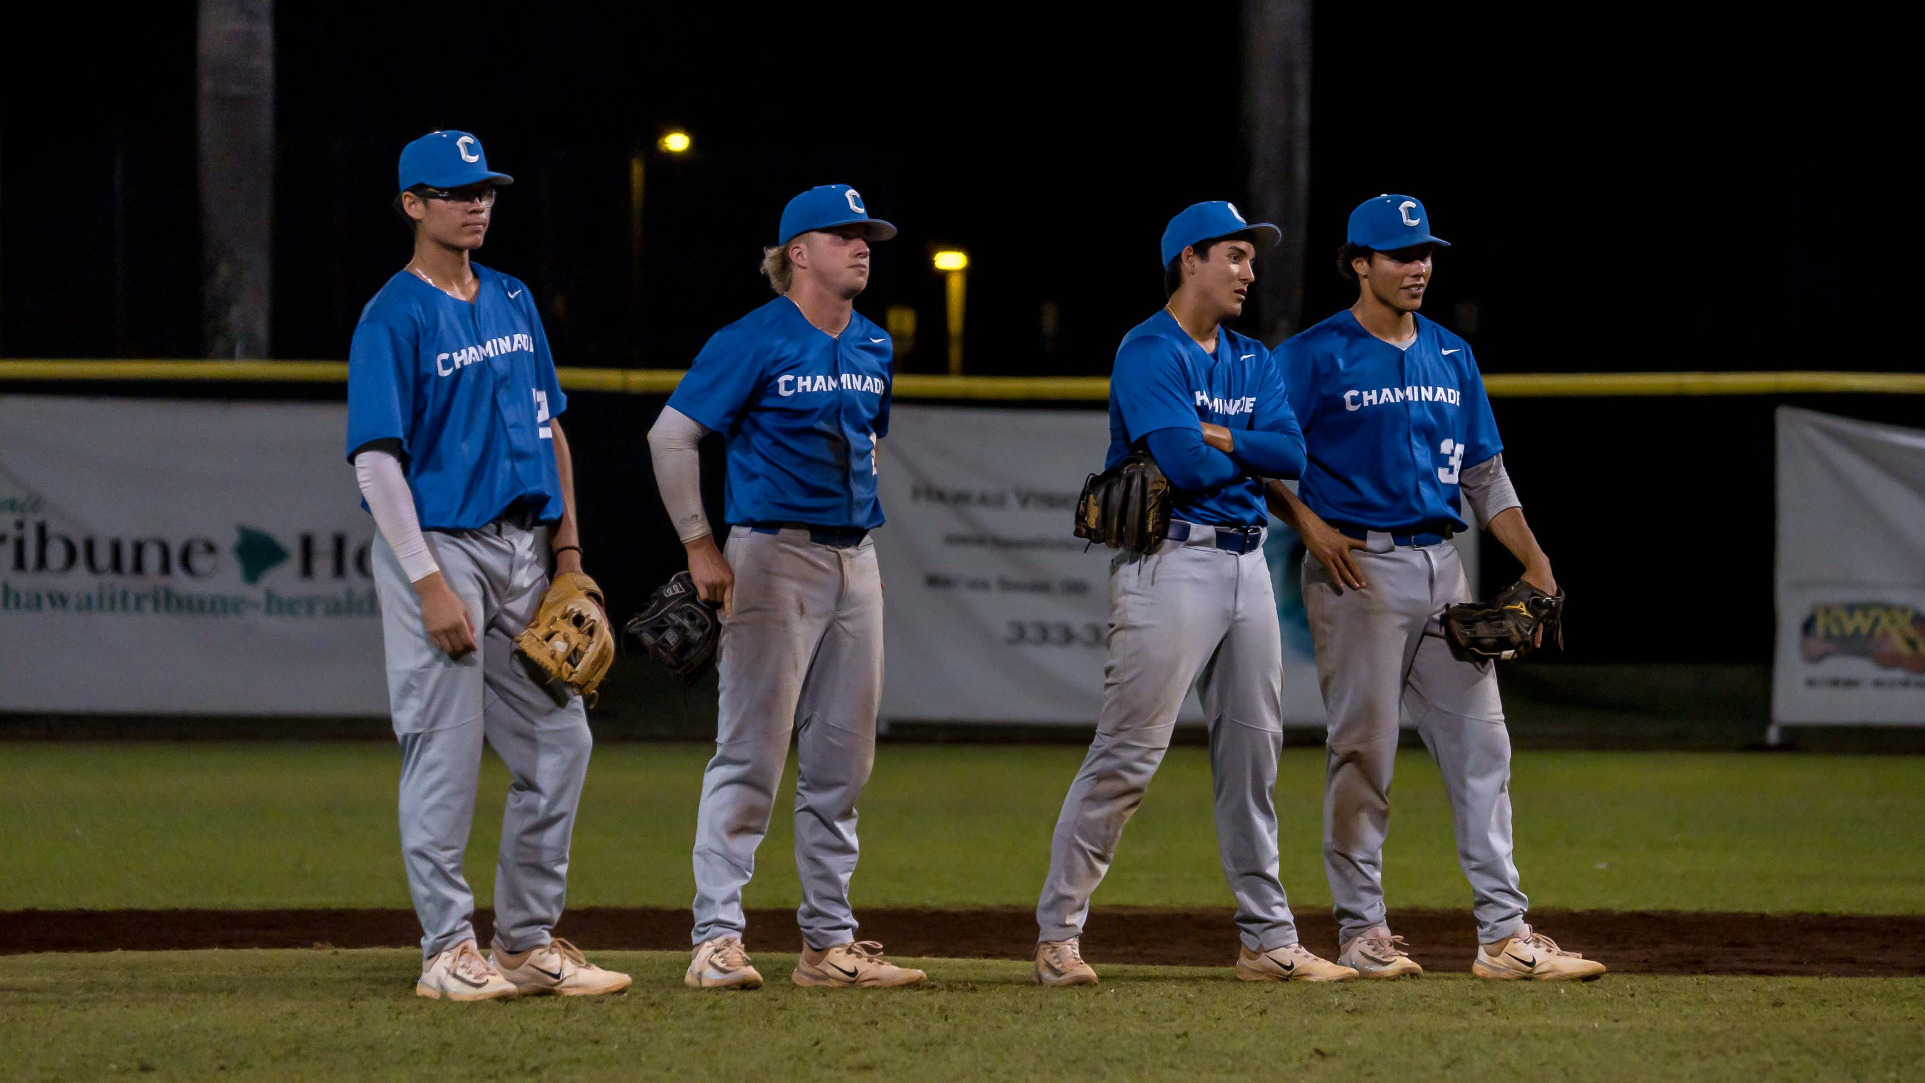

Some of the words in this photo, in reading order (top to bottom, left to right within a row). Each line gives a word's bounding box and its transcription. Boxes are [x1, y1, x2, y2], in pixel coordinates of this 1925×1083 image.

[456, 136, 479, 163] C
[845, 189, 865, 214] C
[1399, 200, 1421, 227] C
[777, 374, 885, 397] CHAMINAD
[532, 387, 554, 439] 2
